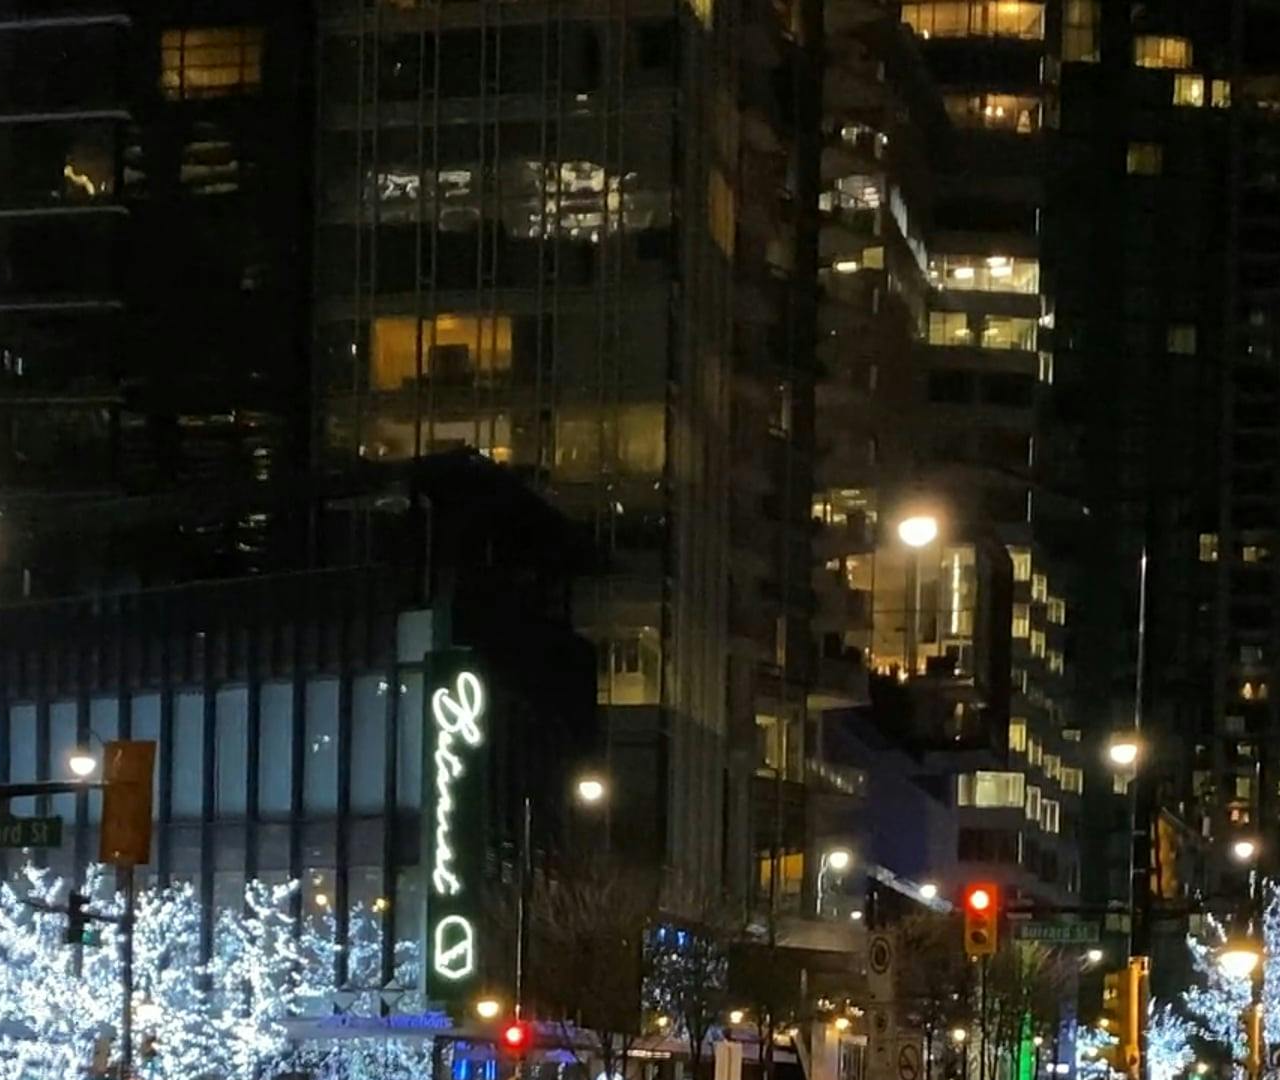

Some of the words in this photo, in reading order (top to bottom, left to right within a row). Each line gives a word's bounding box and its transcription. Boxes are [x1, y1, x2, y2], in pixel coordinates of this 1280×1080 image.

[433, 671, 481, 894] Botanist
[32, 820, 48, 843] St
[1021, 926, 1070, 939] Burrard
